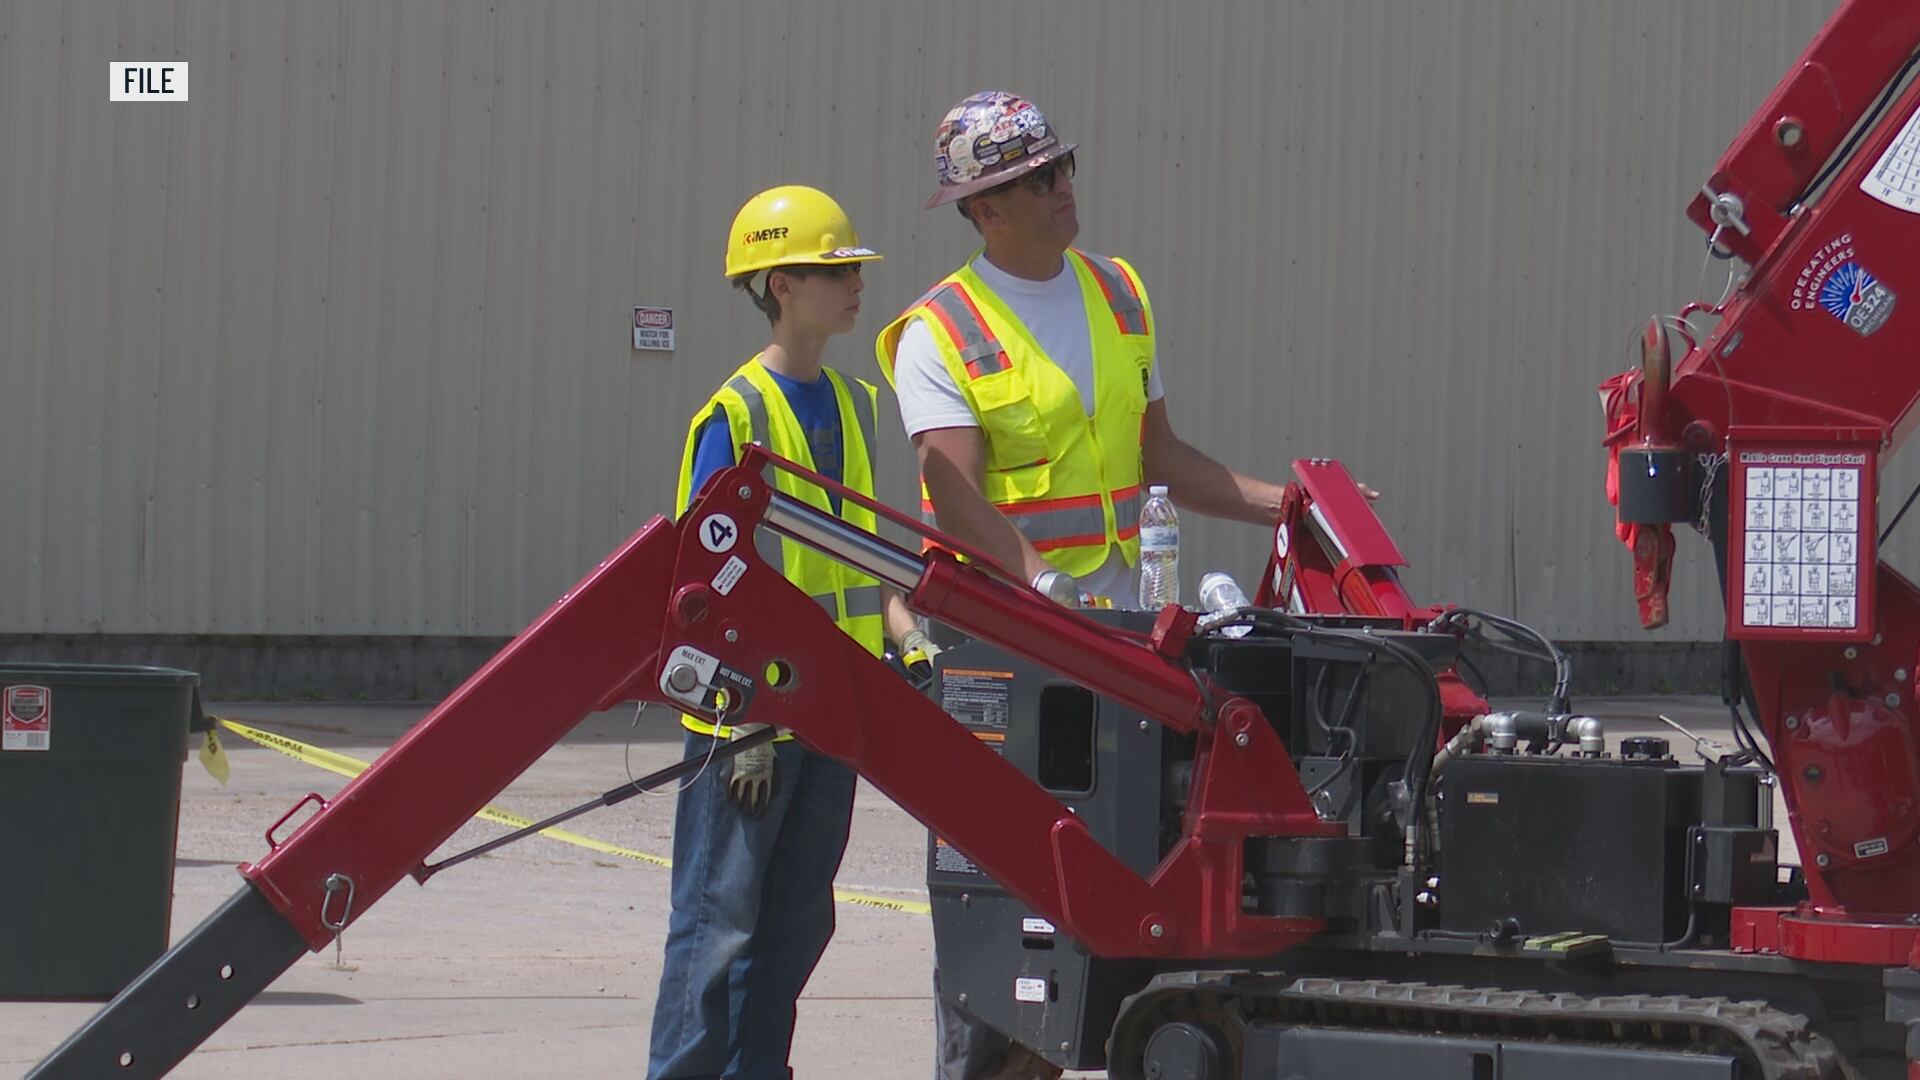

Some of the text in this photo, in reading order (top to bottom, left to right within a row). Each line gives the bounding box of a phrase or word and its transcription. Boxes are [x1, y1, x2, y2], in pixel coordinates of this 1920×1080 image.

[754, 226, 789, 243] MEYER
[1790, 233, 1852, 310] OPERATING
[1804, 247, 1855, 310] ENGINEERS
[1850, 286, 1887, 328] OE324
[639, 312, 668, 325] DANGER
[660, 330, 670, 339] FOR
[640, 339, 660, 348] FALLING
[1768, 453, 1792, 463] Crane
[1793, 453, 1815, 463] Hand
[1815, 453, 1841, 465] Signal
[1841, 454, 1865, 464] Chart
[709, 519, 734, 547] 4
[682, 649, 694, 660] MAX
[720, 667, 753, 688] NOT MAX EXT
